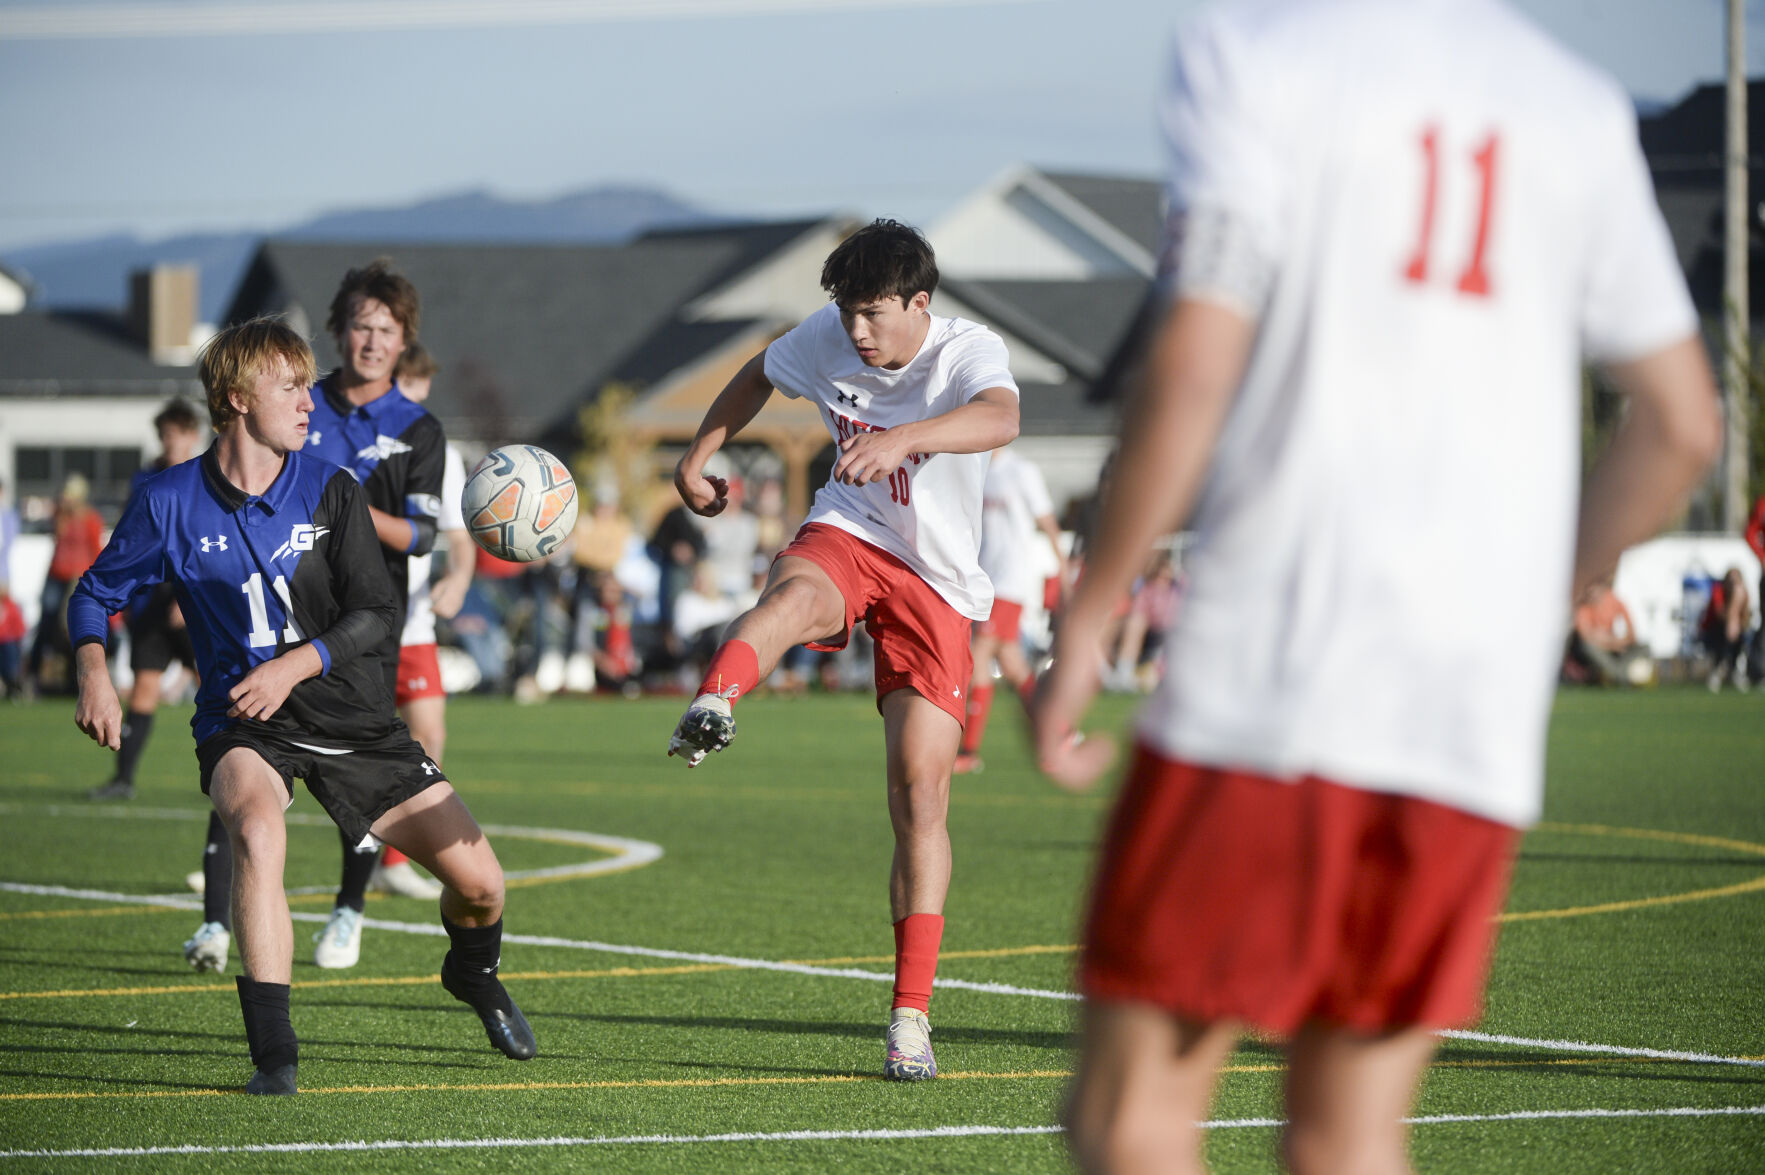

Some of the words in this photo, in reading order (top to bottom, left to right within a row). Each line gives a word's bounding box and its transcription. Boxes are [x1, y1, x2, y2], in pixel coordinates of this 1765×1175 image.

[1401, 122, 1499, 298] 11
[888, 466, 910, 507] 10
[241, 572, 309, 648] 11
